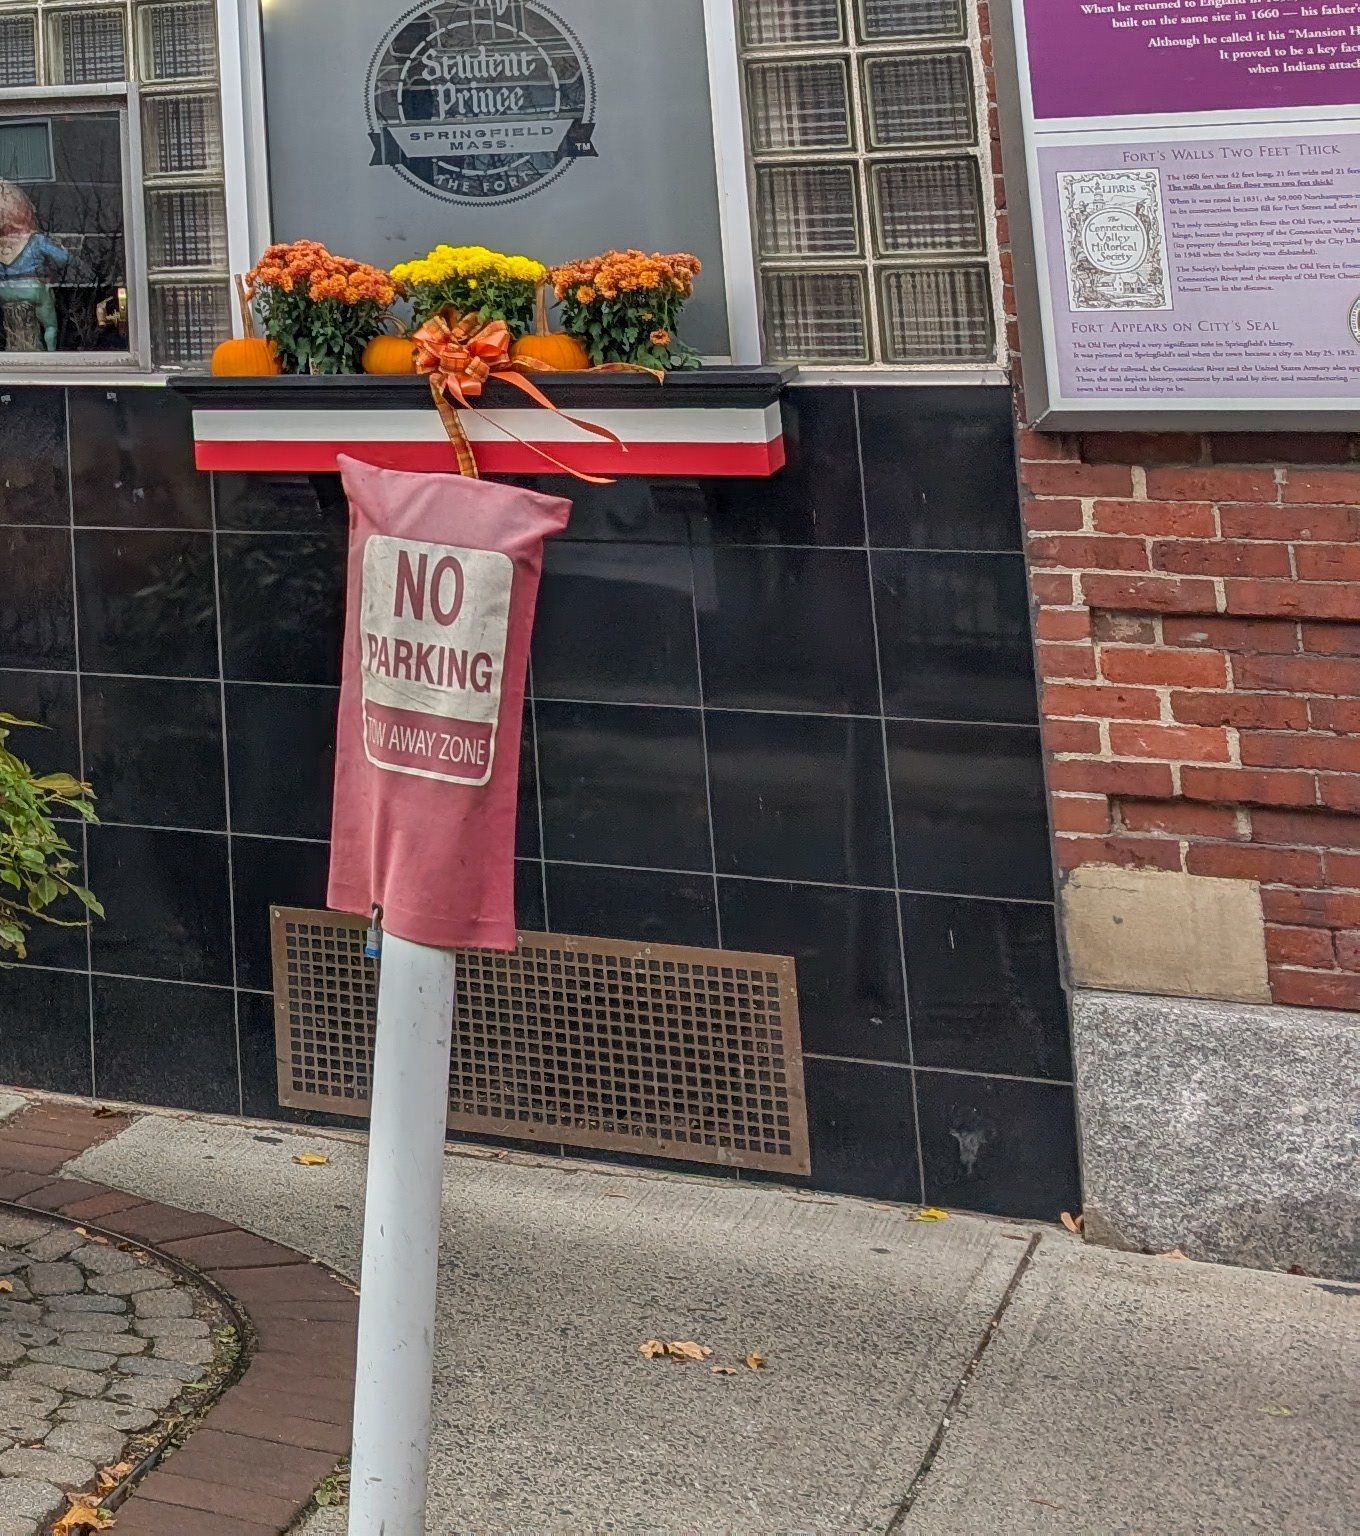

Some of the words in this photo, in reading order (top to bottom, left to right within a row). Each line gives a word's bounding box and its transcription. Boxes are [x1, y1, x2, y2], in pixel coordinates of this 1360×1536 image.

[1080, 4, 1114, 14] When
[1118, 2, 1131, 12] he
[1184, 0, 1196, 8] to
[1112, 18, 1138, 28] built
[1160, 15, 1177, 25] the
[1181, 15, 1208, 24] same
[1212, 11, 1231, 22] site
[1235, 11, 1246, 20] in
[1252, 9, 1279, 20] 1660
[1301, 6, 1318, 16] his
[1148, 34, 1200, 48] Although
[1204, 34, 1217, 44] he
[1221, 32, 1252, 43] called
[1256, 32, 1265, 41] it
[1268, 30, 1285, 40] his
[1219, 50, 1229, 59] It
[1232, 47, 1271, 61] proved
[1275, 48, 1286, 56] to
[1290, 46, 1304, 56] be
[1317, 44, 1337, 56] key
[1341, 42, 1360, 52] fact
[421, 45, 536, 81] Student
[1248, 64, 1279, 74] when
[1283, 61, 1326, 72] Indians
[433, 82, 525, 121] Prince
[409, 126, 554, 142] SPRINGFIELD
[450, 140, 514, 151] MASS.
[1122, 150, 1166, 162] FORT'S
[1172, 148, 1214, 161] WALLS
[1219, 146, 1253, 159] TWO
[1259, 145, 1292, 157] FEET
[1296, 143, 1342, 156] THICK
[435, 173, 470, 193] THE
[483, 171, 530, 193] FORT
[1080, 185, 1095, 194] EX
[1102, 184, 1136, 193] LIBRIS
[1089, 223, 1139, 232] Connecticut
[1096, 232, 1130, 243] Valley
[1097, 252, 1133, 266] Society
[1071, 322, 1104, 333] FORT
[1110, 322, 1168, 333] APPEARS
[1172, 322, 1192, 332] ON
[1198, 320, 1241, 332] CITY'S
[1247, 320, 1280, 331] SEAL
[393, 549, 464, 626] NO
[367, 633, 492, 693] PARKING
[367, 716, 386, 748] TOW
[388, 724, 436, 757] AWAY
[438, 733, 486, 765] ZONE
